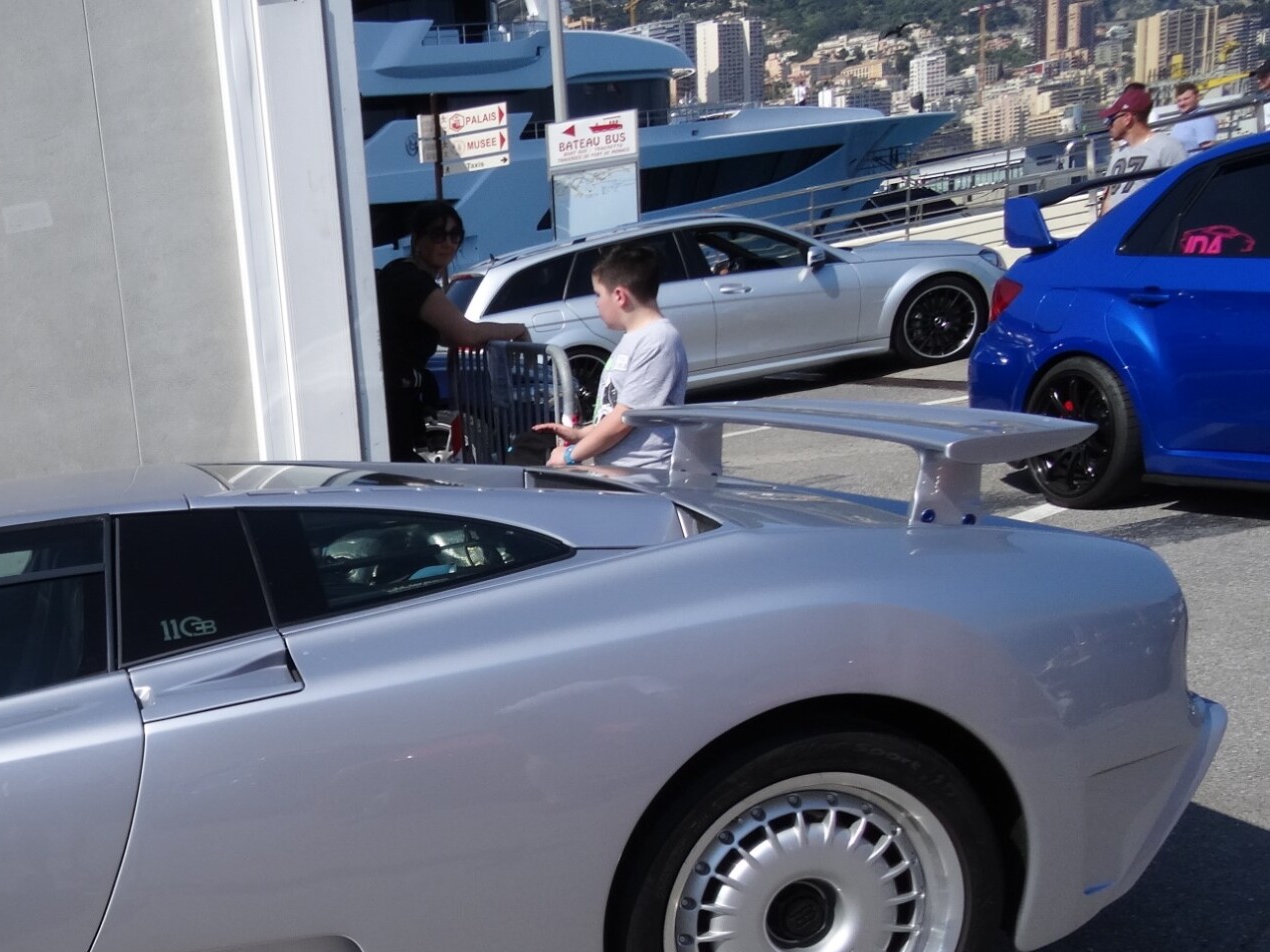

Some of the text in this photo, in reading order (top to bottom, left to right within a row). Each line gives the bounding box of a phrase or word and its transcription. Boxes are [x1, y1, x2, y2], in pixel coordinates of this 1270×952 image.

[465, 111, 497, 125] PALAIS
[466, 137, 497, 151] MUSEE
[558, 132, 626, 152] BATEAU BUS
